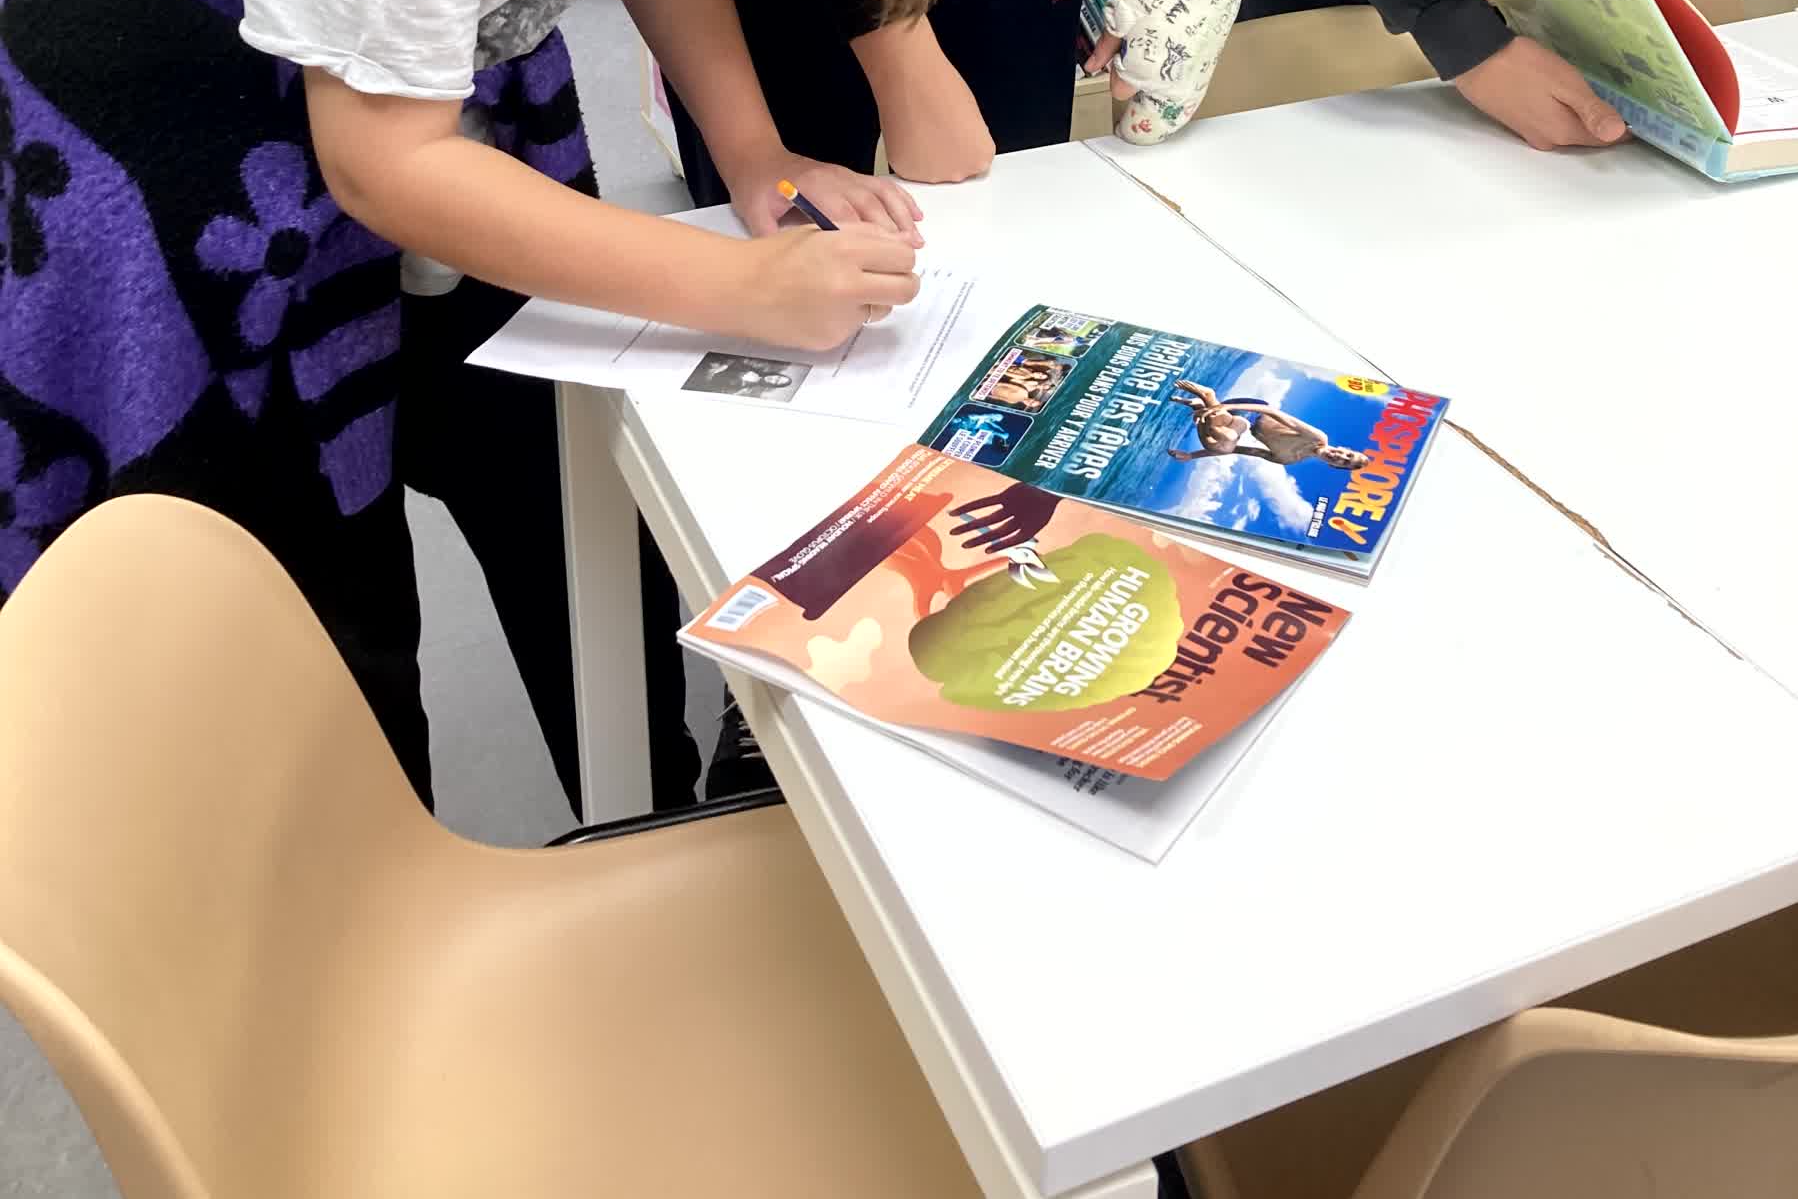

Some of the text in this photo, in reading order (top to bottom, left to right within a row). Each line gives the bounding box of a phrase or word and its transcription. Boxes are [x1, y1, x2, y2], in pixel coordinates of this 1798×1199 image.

[1034, 332, 1153, 470] NOS BONS PLANS POUR Y ARRIVER
[1101, 391, 1161, 423] tes
[1062, 424, 1131, 480] rêves
[1333, 387, 1441, 521] PHOSPHORE
[1068, 566, 1150, 646] HUMAN
[1136, 572, 1283, 703] Scientist
[1242, 591, 1333, 668] New
[1003, 640, 1084, 706] BRAINS
[1053, 602, 1149, 696] GROWING
